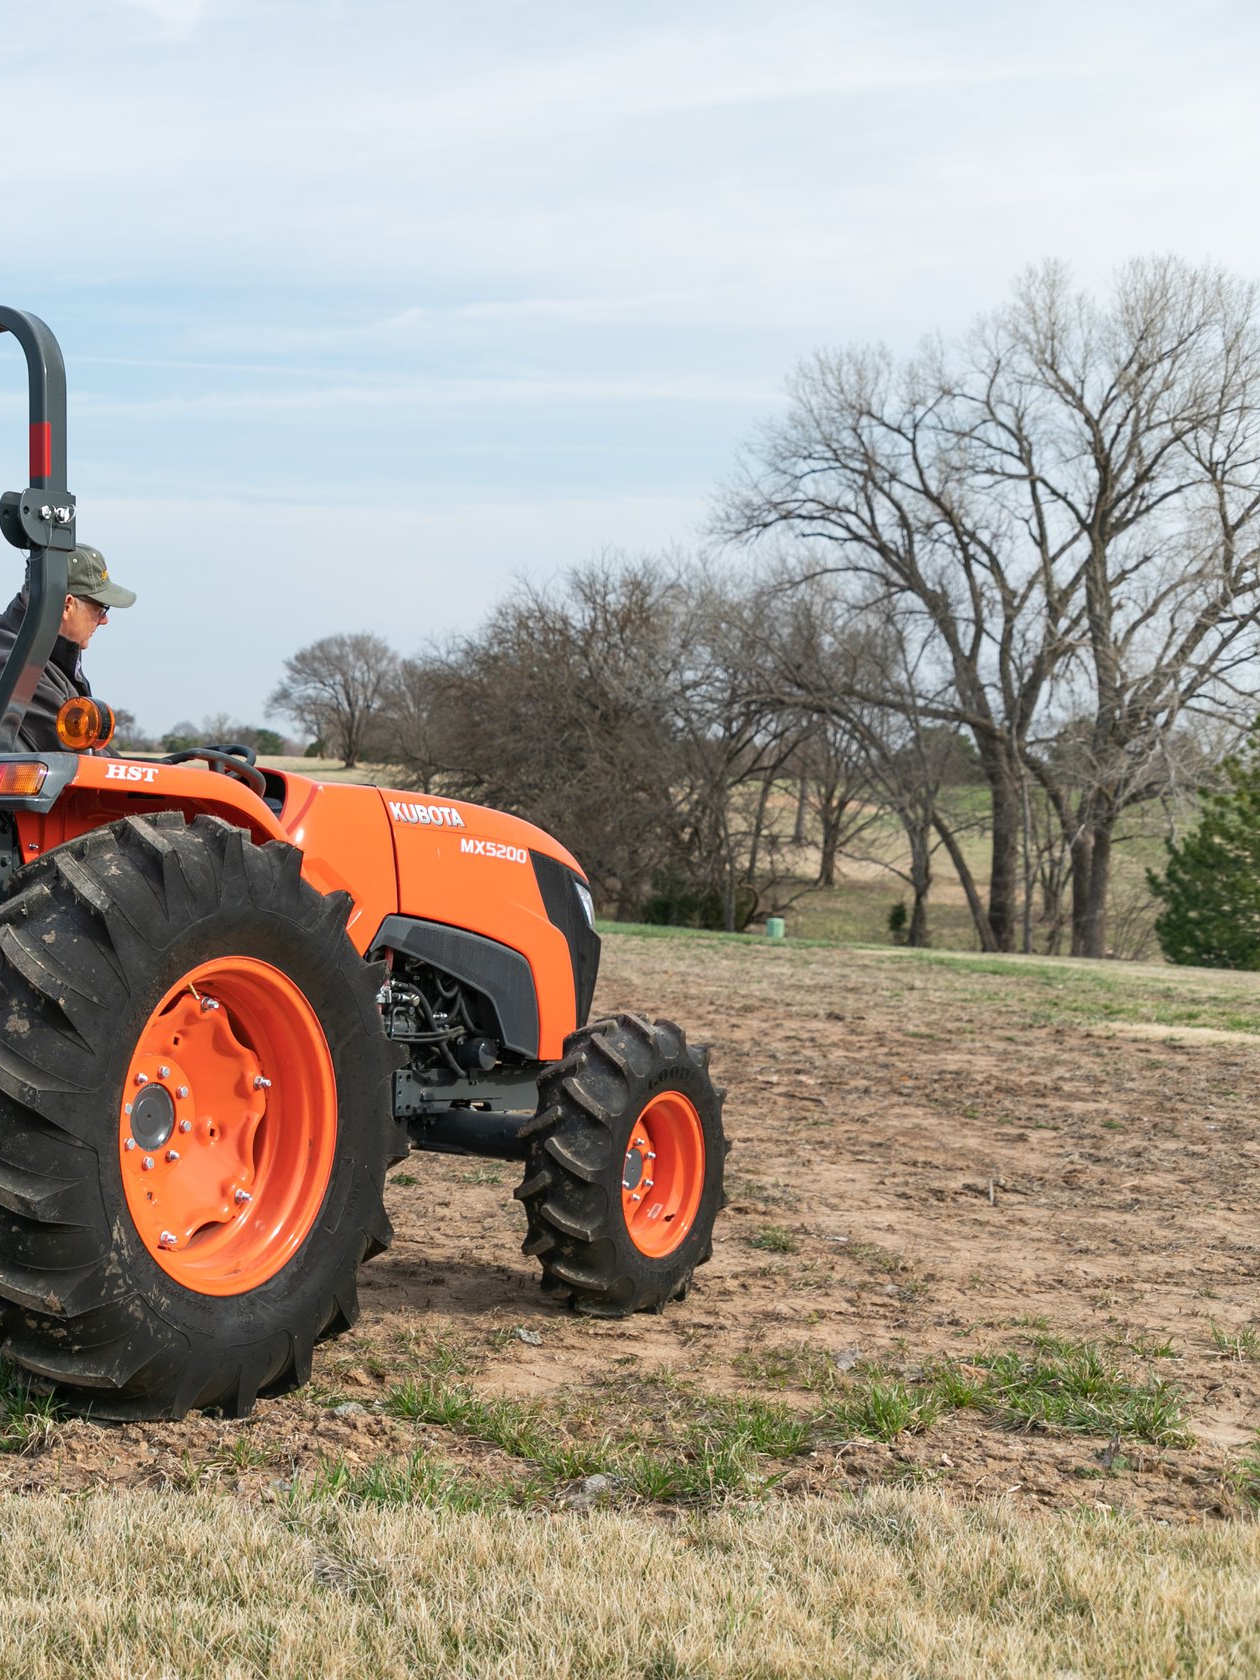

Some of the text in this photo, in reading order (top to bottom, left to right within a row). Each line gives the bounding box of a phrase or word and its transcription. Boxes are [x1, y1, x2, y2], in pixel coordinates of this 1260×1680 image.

[105, 764, 159, 783] HST
[389, 801, 466, 828] KUBOTA
[460, 838, 527, 864] MX5200
